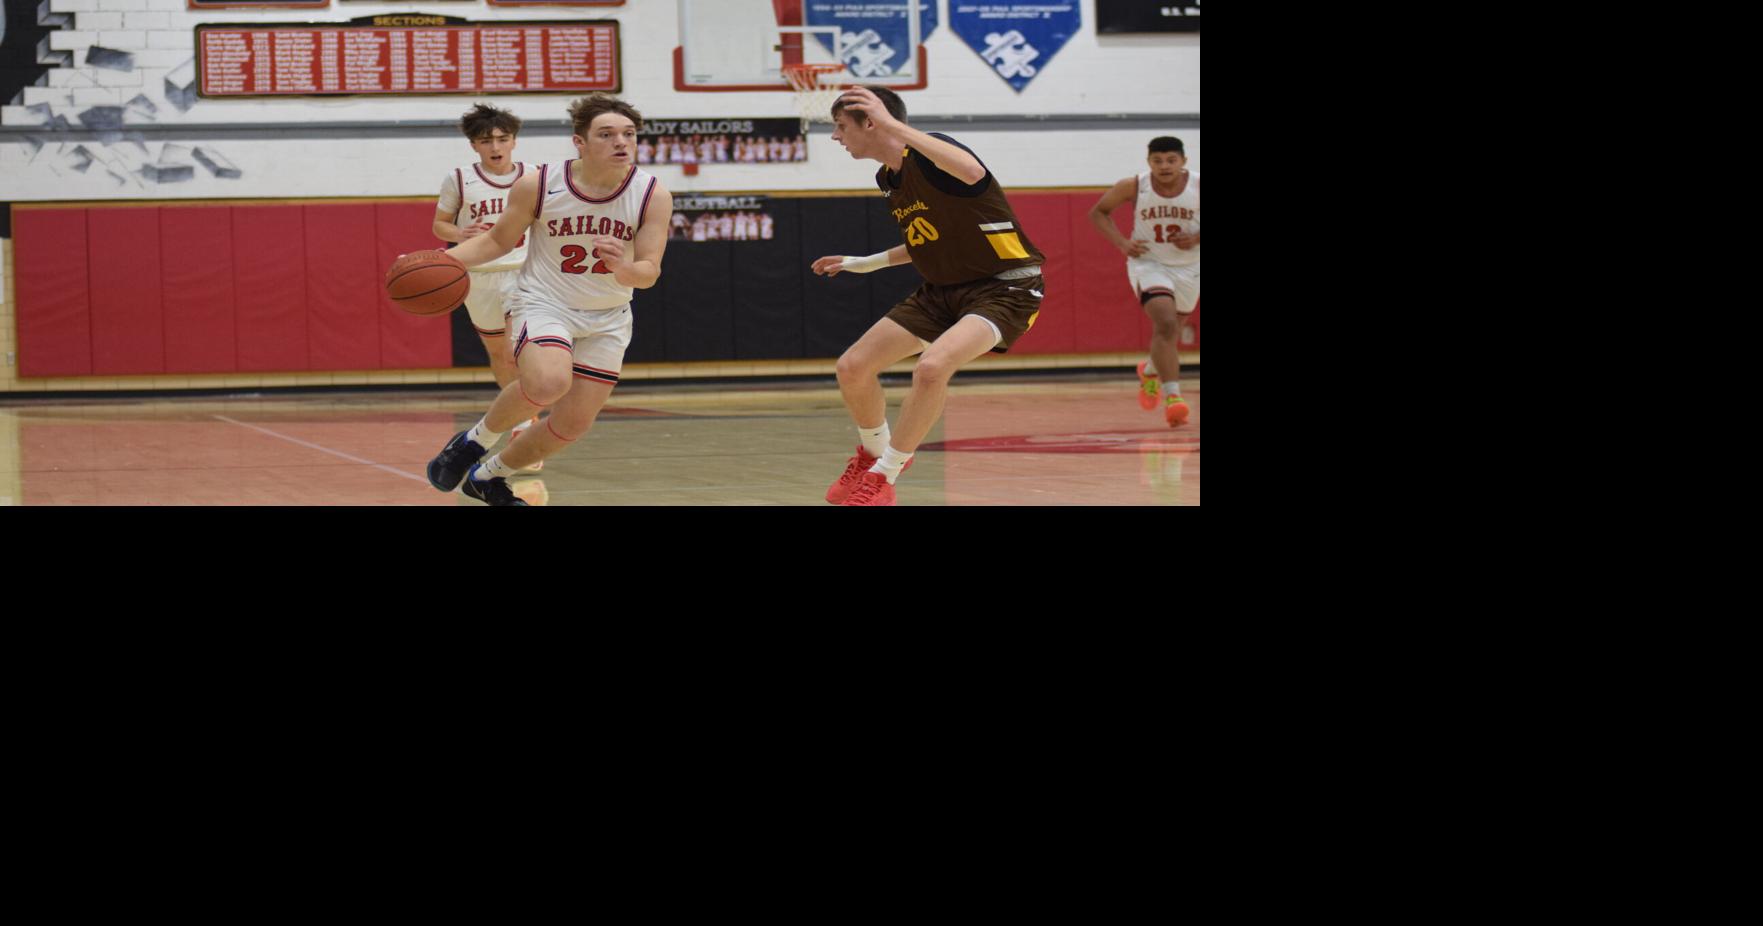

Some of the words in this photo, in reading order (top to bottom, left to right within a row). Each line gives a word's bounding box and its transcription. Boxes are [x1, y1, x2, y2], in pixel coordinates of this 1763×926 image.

[373, 16, 446, 26] SECTIONS
[637, 121, 677, 135] ADY
[680, 120, 754, 134] SAILORS
[672, 197, 761, 209] SKETBALL
[1140, 205, 1195, 221] SAILORS
[547, 215, 633, 242] SAILORS
[905, 216, 939, 247] 20
[1153, 224, 1181, 244] 12
